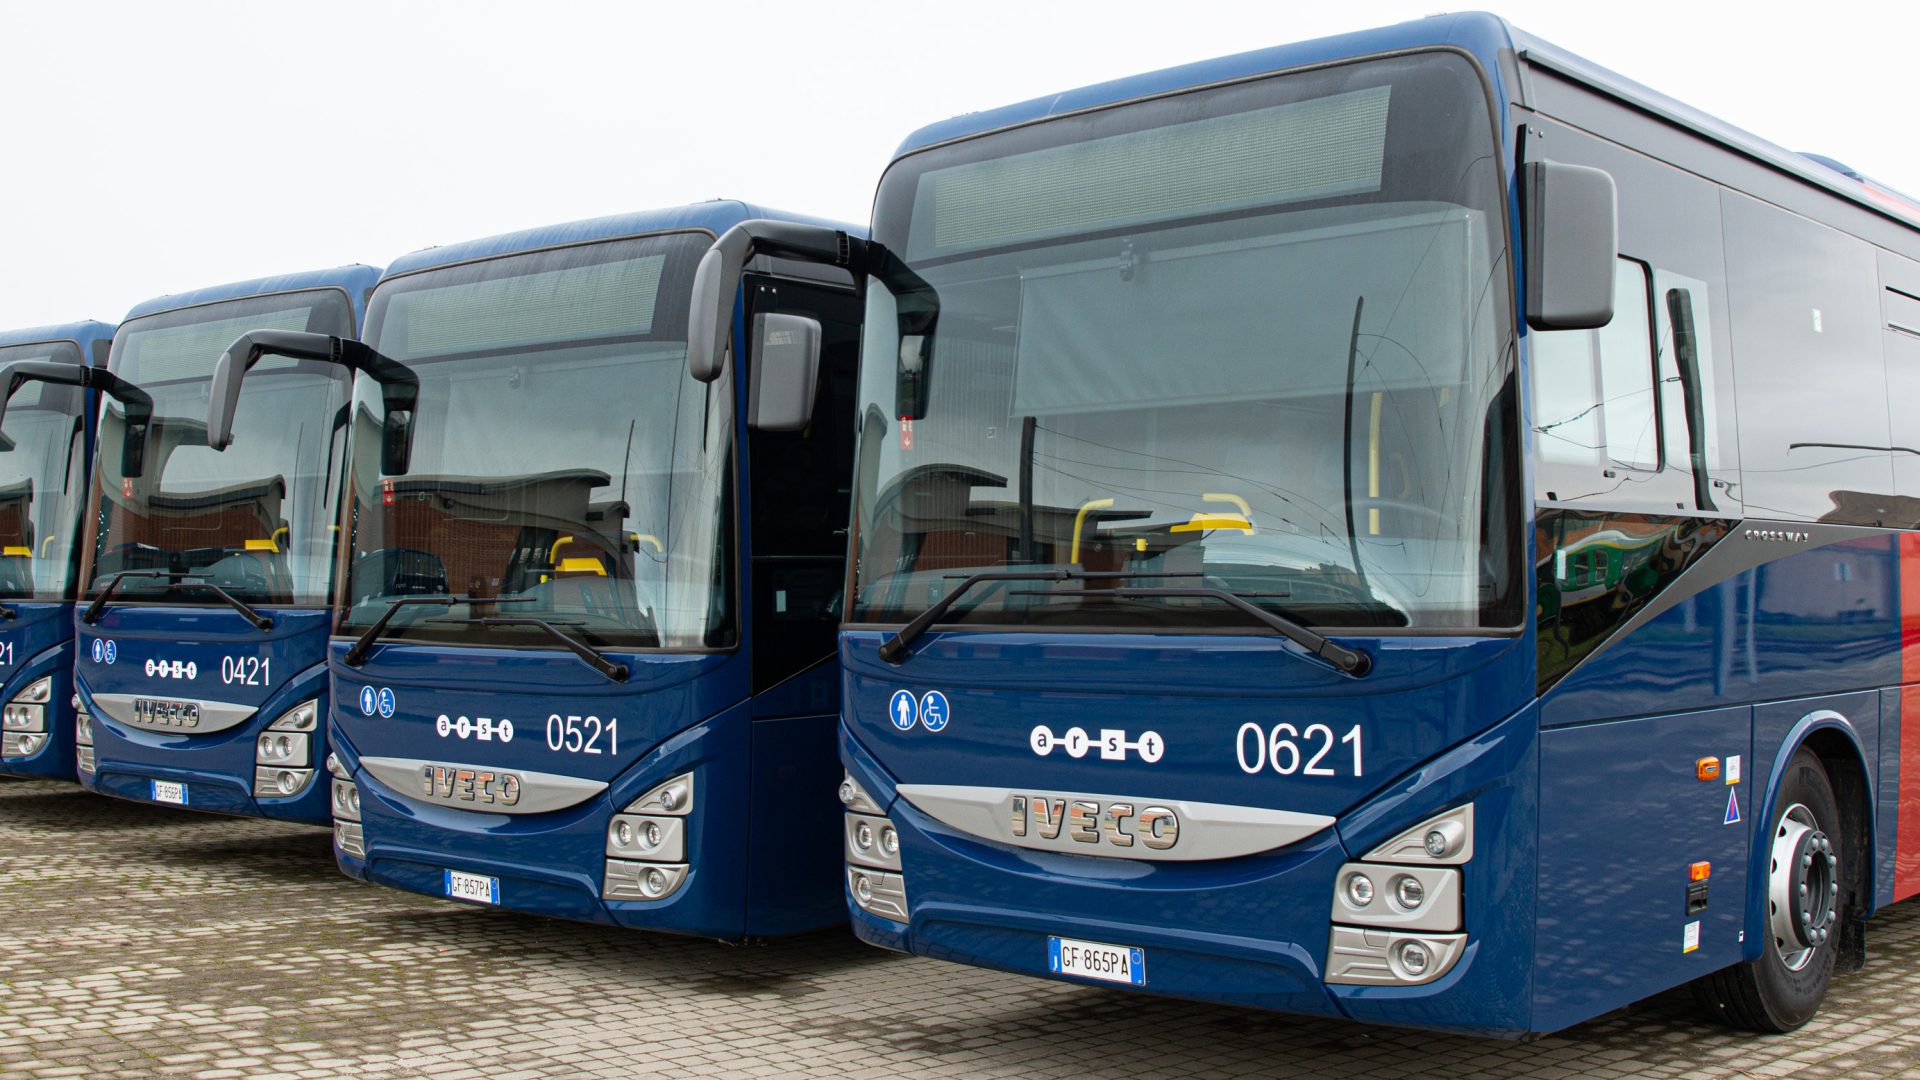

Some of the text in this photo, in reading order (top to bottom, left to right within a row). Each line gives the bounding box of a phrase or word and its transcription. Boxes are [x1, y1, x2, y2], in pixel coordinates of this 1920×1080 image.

[1745, 530, 1809, 542] CROSSWAY
[222, 655, 270, 686] 0421
[134, 698, 200, 728] IVECO
[438, 718, 511, 740] arst
[546, 714, 617, 755] 0521
[1034, 729, 1158, 759] arst
[1236, 722, 1363, 777] 0621
[424, 765, 520, 806] IVECO
[1012, 796, 1180, 850] IVECO
